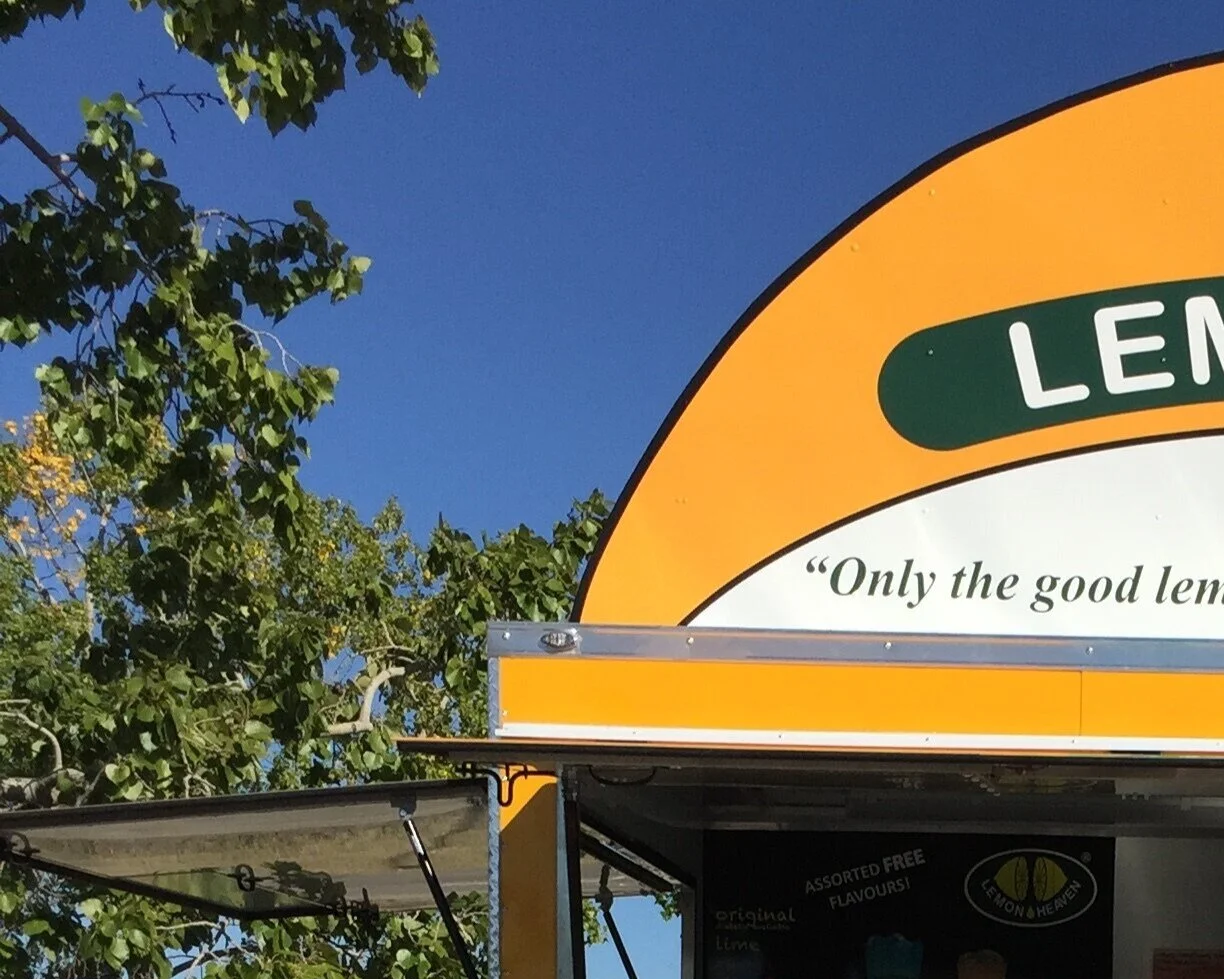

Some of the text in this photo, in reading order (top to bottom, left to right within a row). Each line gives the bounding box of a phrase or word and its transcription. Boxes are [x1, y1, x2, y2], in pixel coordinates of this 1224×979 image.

[805, 556, 935, 609] “Only
[950, 561, 1017, 600] the
[1029, 565, 1144, 613] good
[805, 848, 926, 894] ASSORTED FREE
[828, 876, 911, 910] FLAVOURS!
[981, 878, 1082, 918] LEMON HEAVEN
[716, 906, 796, 928] original
